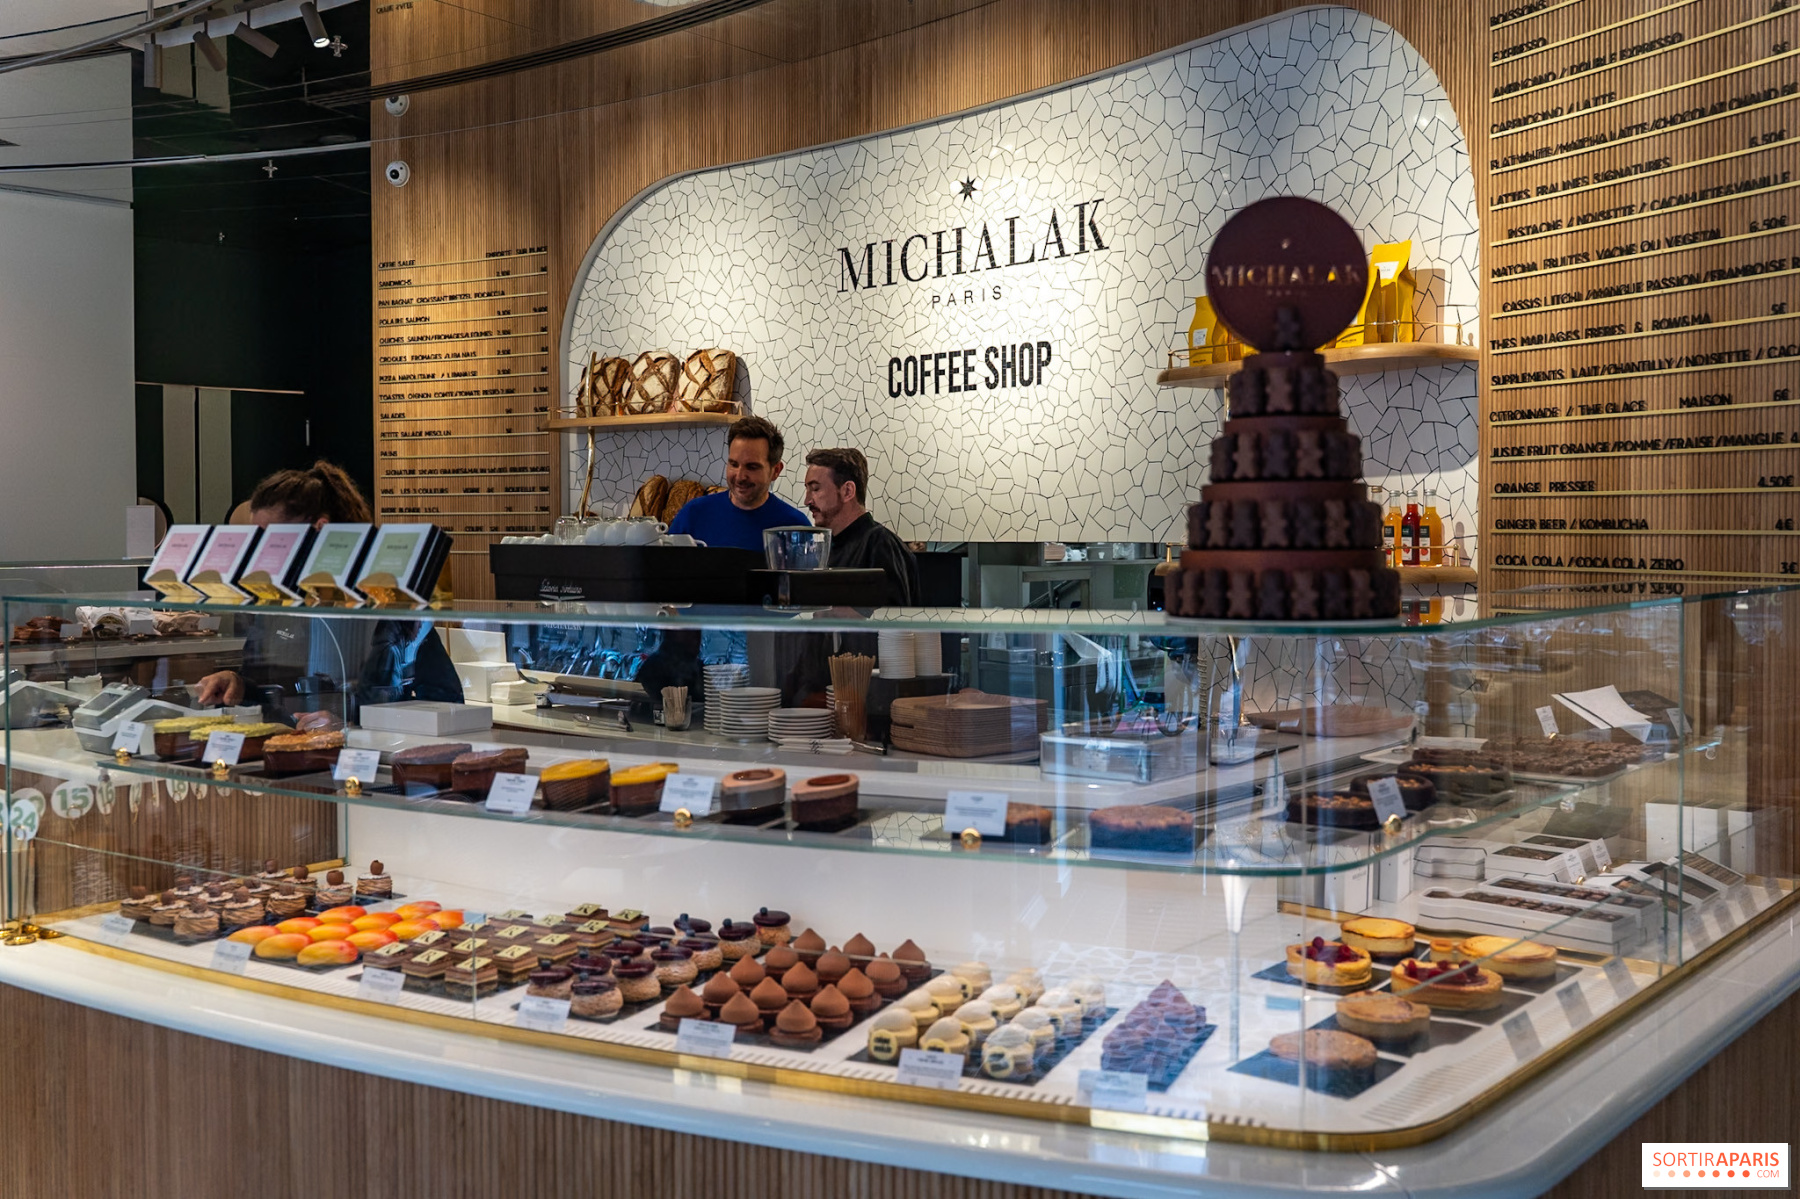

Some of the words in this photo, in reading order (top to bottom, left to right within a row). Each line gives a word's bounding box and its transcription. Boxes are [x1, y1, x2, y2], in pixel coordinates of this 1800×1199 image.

[1490, 1, 1546, 26] BOISSONS
[1492, 37, 1548, 62] EXPRESSO
[1570, 52, 1616, 75] DOUBLE
[1620, 32, 1682, 60] EXPRESSO
[1490, 106, 1562, 134] CAPPUCCINO
[1576, 91, 1616, 111] LATTE
[1609, 122, 1648, 141] LATTE
[1490, 188, 1530, 206] LATTES
[1536, 175, 1589, 196] PRALINES
[1592, 157, 1672, 184] SIGNATURES
[1508, 219, 1562, 238] PISTACHE
[1576, 204, 1636, 225] NOISETTE
[837, 198, 1109, 293] MICHALAK
[1491, 261, 1538, 278] MATCHA
[1596, 244, 1637, 260] VACHE
[1640, 240, 1661, 252] OU
[1664, 228, 1724, 248] VEGETAL
[932, 286, 1002, 309] PARIS
[1502, 297, 1542, 312] CASSIS
[1646, 273, 1700, 291] PASSION
[1489, 337, 1517, 349] THES
[1520, 330, 1580, 346] MARIAGES
[1584, 324, 1626, 338] FRERES
[1634, 322, 1644, 332] &
[888, 349, 977, 398] COFFEE
[984, 341, 1052, 389] SHOP
[1490, 368, 1564, 385] SUPPLEMENTS
[1490, 406, 1559, 421] CITRONNADE
[1578, 403, 1602, 415] THE
[1604, 400, 1646, 413] GLACE
[1678, 393, 1732, 408] MAISON
[1527, 444, 1558, 455] FRUIT
[1560, 441, 1610, 454] ORANGE
[1494, 481, 1540, 493] ORANGE
[1548, 480, 1596, 491] PRESSEE
[1757, 476, 1794, 487] 4.50€
[1494, 518, 1536, 529] GINGER
[1538, 518, 1566, 529] BEER
[1578, 518, 1648, 530] KOMBUCHA
[1774, 519, 1794, 531] 4€
[1495, 554, 1527, 566] COCA
[1532, 555, 1563, 567] COLA
[1612, 557, 1647, 569] COLA
[1650, 558, 1684, 571] ZERO
[1780, 562, 1798, 574] 3€
[56, 787, 90, 811] 15
[11, 806, 36, 832] 24
